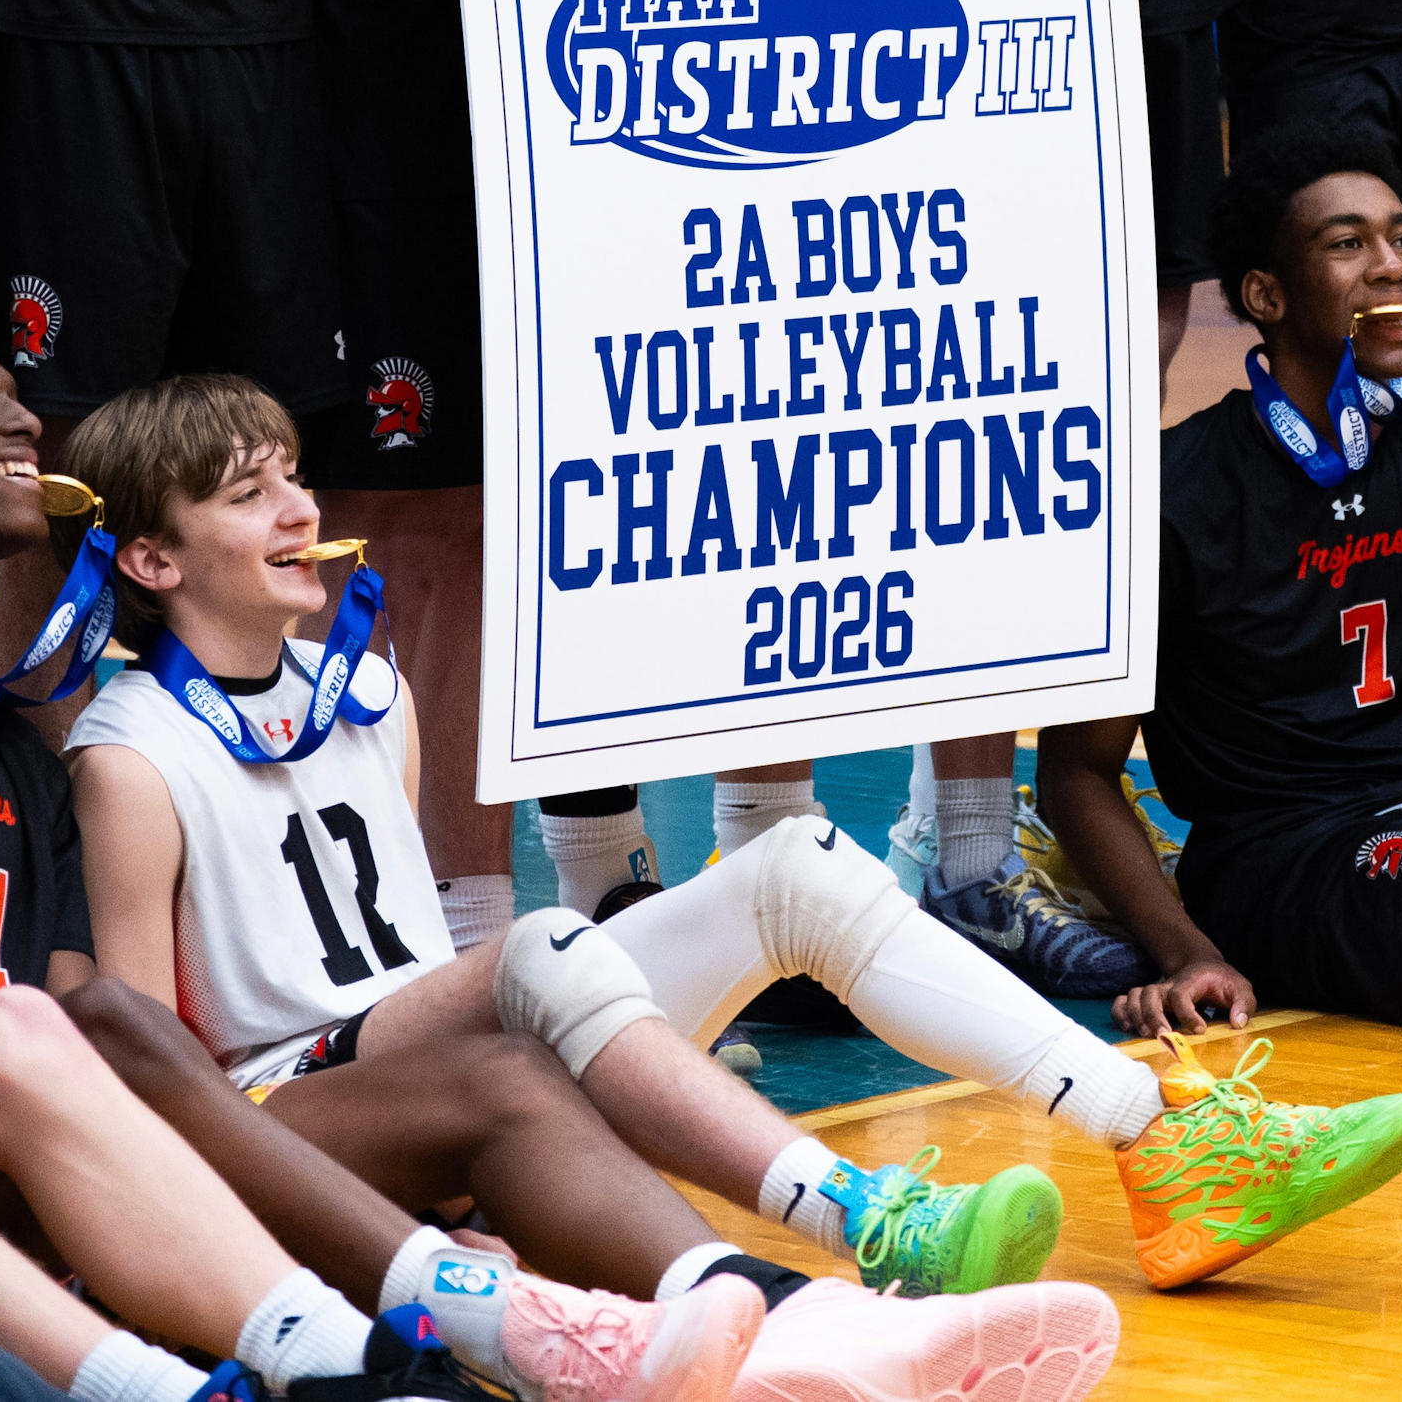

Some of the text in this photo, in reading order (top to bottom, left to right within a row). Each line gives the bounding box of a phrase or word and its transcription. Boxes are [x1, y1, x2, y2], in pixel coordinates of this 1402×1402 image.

[570, 15, 1075, 146] DISTRICT III
[682, 187, 969, 309] 2A BOYS
[594, 296, 1058, 435] VOLLEYBALL
[1267, 406, 1313, 459] DISTRICT
[1347, 407, 1367, 468] DISTRICT
[548, 406, 1102, 591] CHAMPIONS
[28, 606, 77, 670] DISTRICT
[742, 570, 914, 686] 2026
[1340, 599, 1396, 709] 7
[182, 684, 240, 745] DISTRICT
[318, 654, 349, 731] DISTRICT
